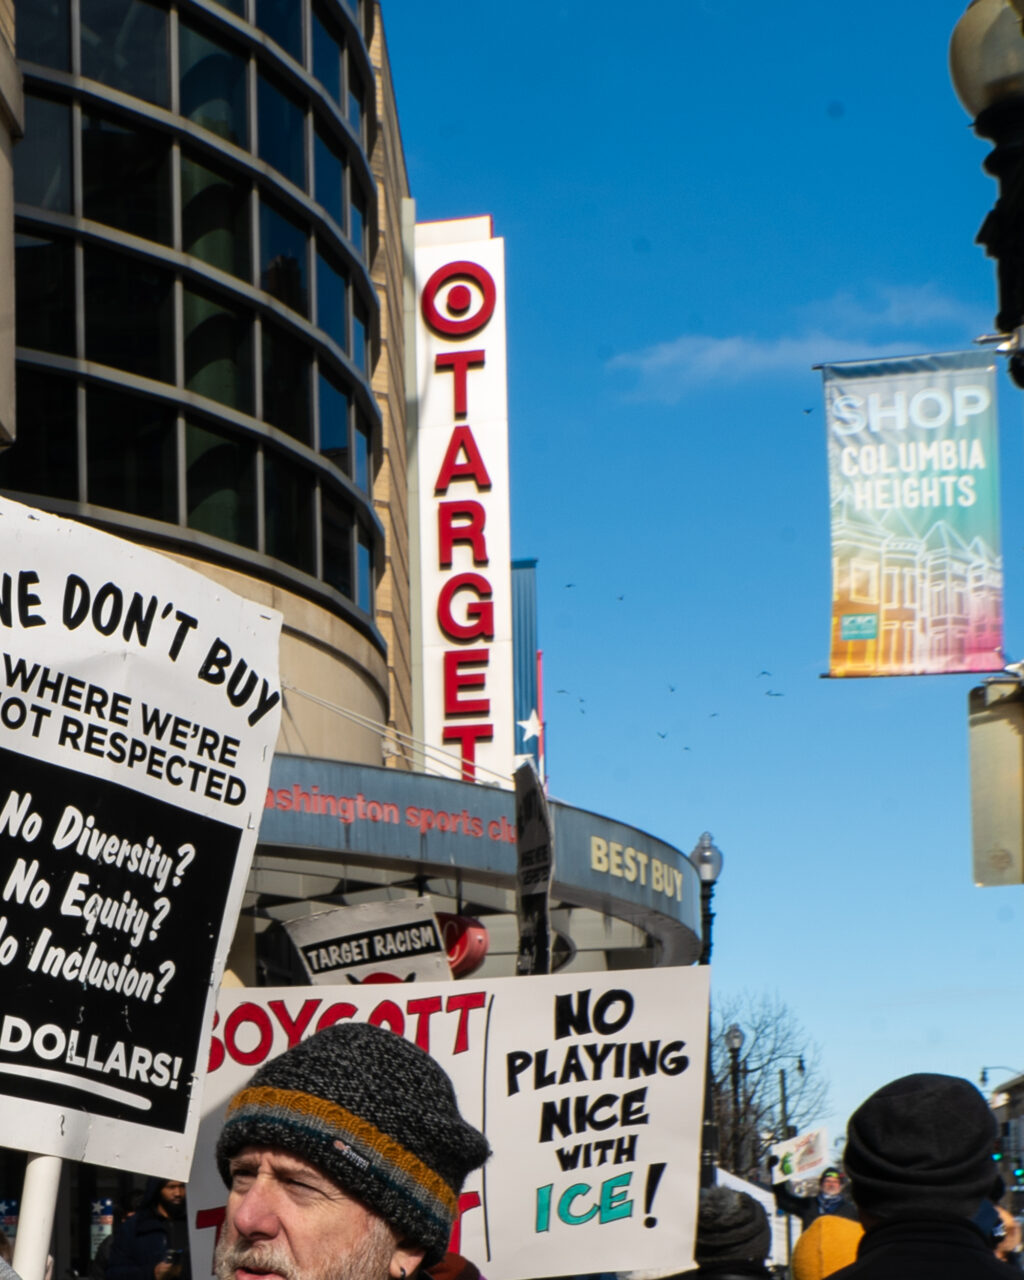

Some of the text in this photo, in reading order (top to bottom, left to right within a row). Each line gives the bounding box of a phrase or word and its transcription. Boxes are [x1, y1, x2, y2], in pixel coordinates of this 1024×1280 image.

[831, 384, 991, 436] SHOP
[840, 438, 987, 478] COLUMBIA
[853, 474, 977, 511] HEIGHTS
[432, 349, 495, 783] TARGET
[62, 573, 198, 662] DON'T
[198, 637, 280, 727] BUY
[3, 653, 241, 769] WHERE WE'RE
[58, 715, 247, 806] RESPECTED
[265, 784, 399, 825] ashington
[405, 805, 484, 837] sports
[53, 805, 196, 893] Diversity?
[590, 835, 649, 886] BEST
[651, 858, 683, 902] BUY
[3, 858, 171, 948] No Equity?
[28, 927, 176, 1004] Inclusion?
[307, 926, 436, 971] TARGET RACISM
[554, 988, 635, 1041] NO
[0, 1014, 183, 1090] DOLLARS!
[506, 1039, 691, 1097] PLAYING
[538, 1086, 650, 1143] NICE
[555, 1134, 639, 1172] WITH
